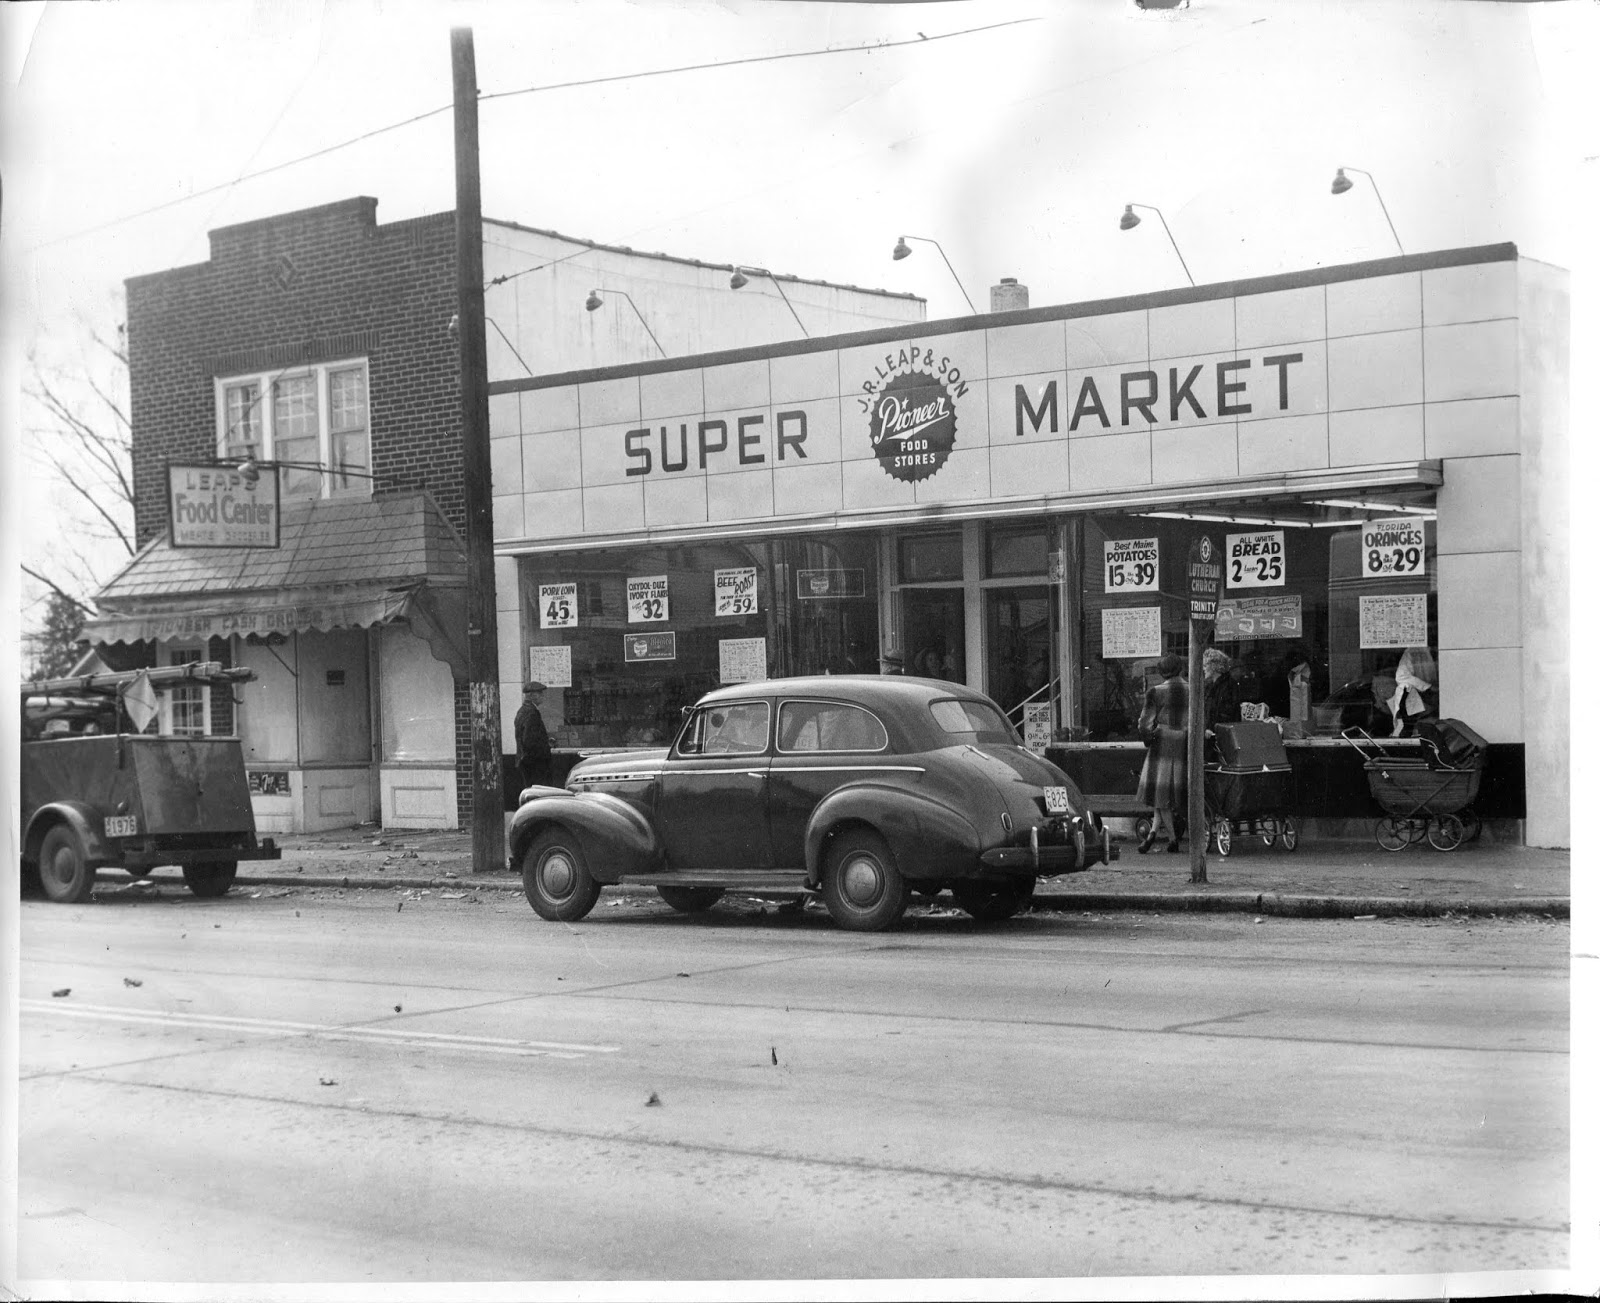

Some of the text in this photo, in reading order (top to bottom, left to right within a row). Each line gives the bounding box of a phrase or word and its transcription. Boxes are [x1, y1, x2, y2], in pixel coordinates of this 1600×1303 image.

[938, 357, 969, 399] SON
[1015, 352, 1304, 437] MARKET
[874, 396, 950, 445] Pioneer
[625, 409, 808, 477] SUPER
[900, 439, 928, 452] FOOD
[894, 453, 936, 468] STORES
[175, 493, 273, 525] Food Center
[1377, 522, 1412, 531] FLORIDA
[1114, 540, 1154, 550] Best Maine
[1254, 535, 1275, 543] WHITE
[1364, 530, 1423, 548] ORANGES
[1106, 549, 1158, 563] POTATOES
[1231, 542, 1281, 558] BREAD
[1368, 549, 1382, 572] 8
[1109, 564, 1126, 587] 15
[1188, 563, 1220, 578] LUTHERAN
[1231, 559, 1242, 583] 2
[542, 585, 575, 597] PORK LOIN
[717, 573, 755, 595] BEEF ROAST
[1191, 579, 1217, 593] CHURCH
[629, 591, 649, 600] IVORY
[1190, 600, 1217, 612] TRINITY
[112, 819, 135, 834] 1976
